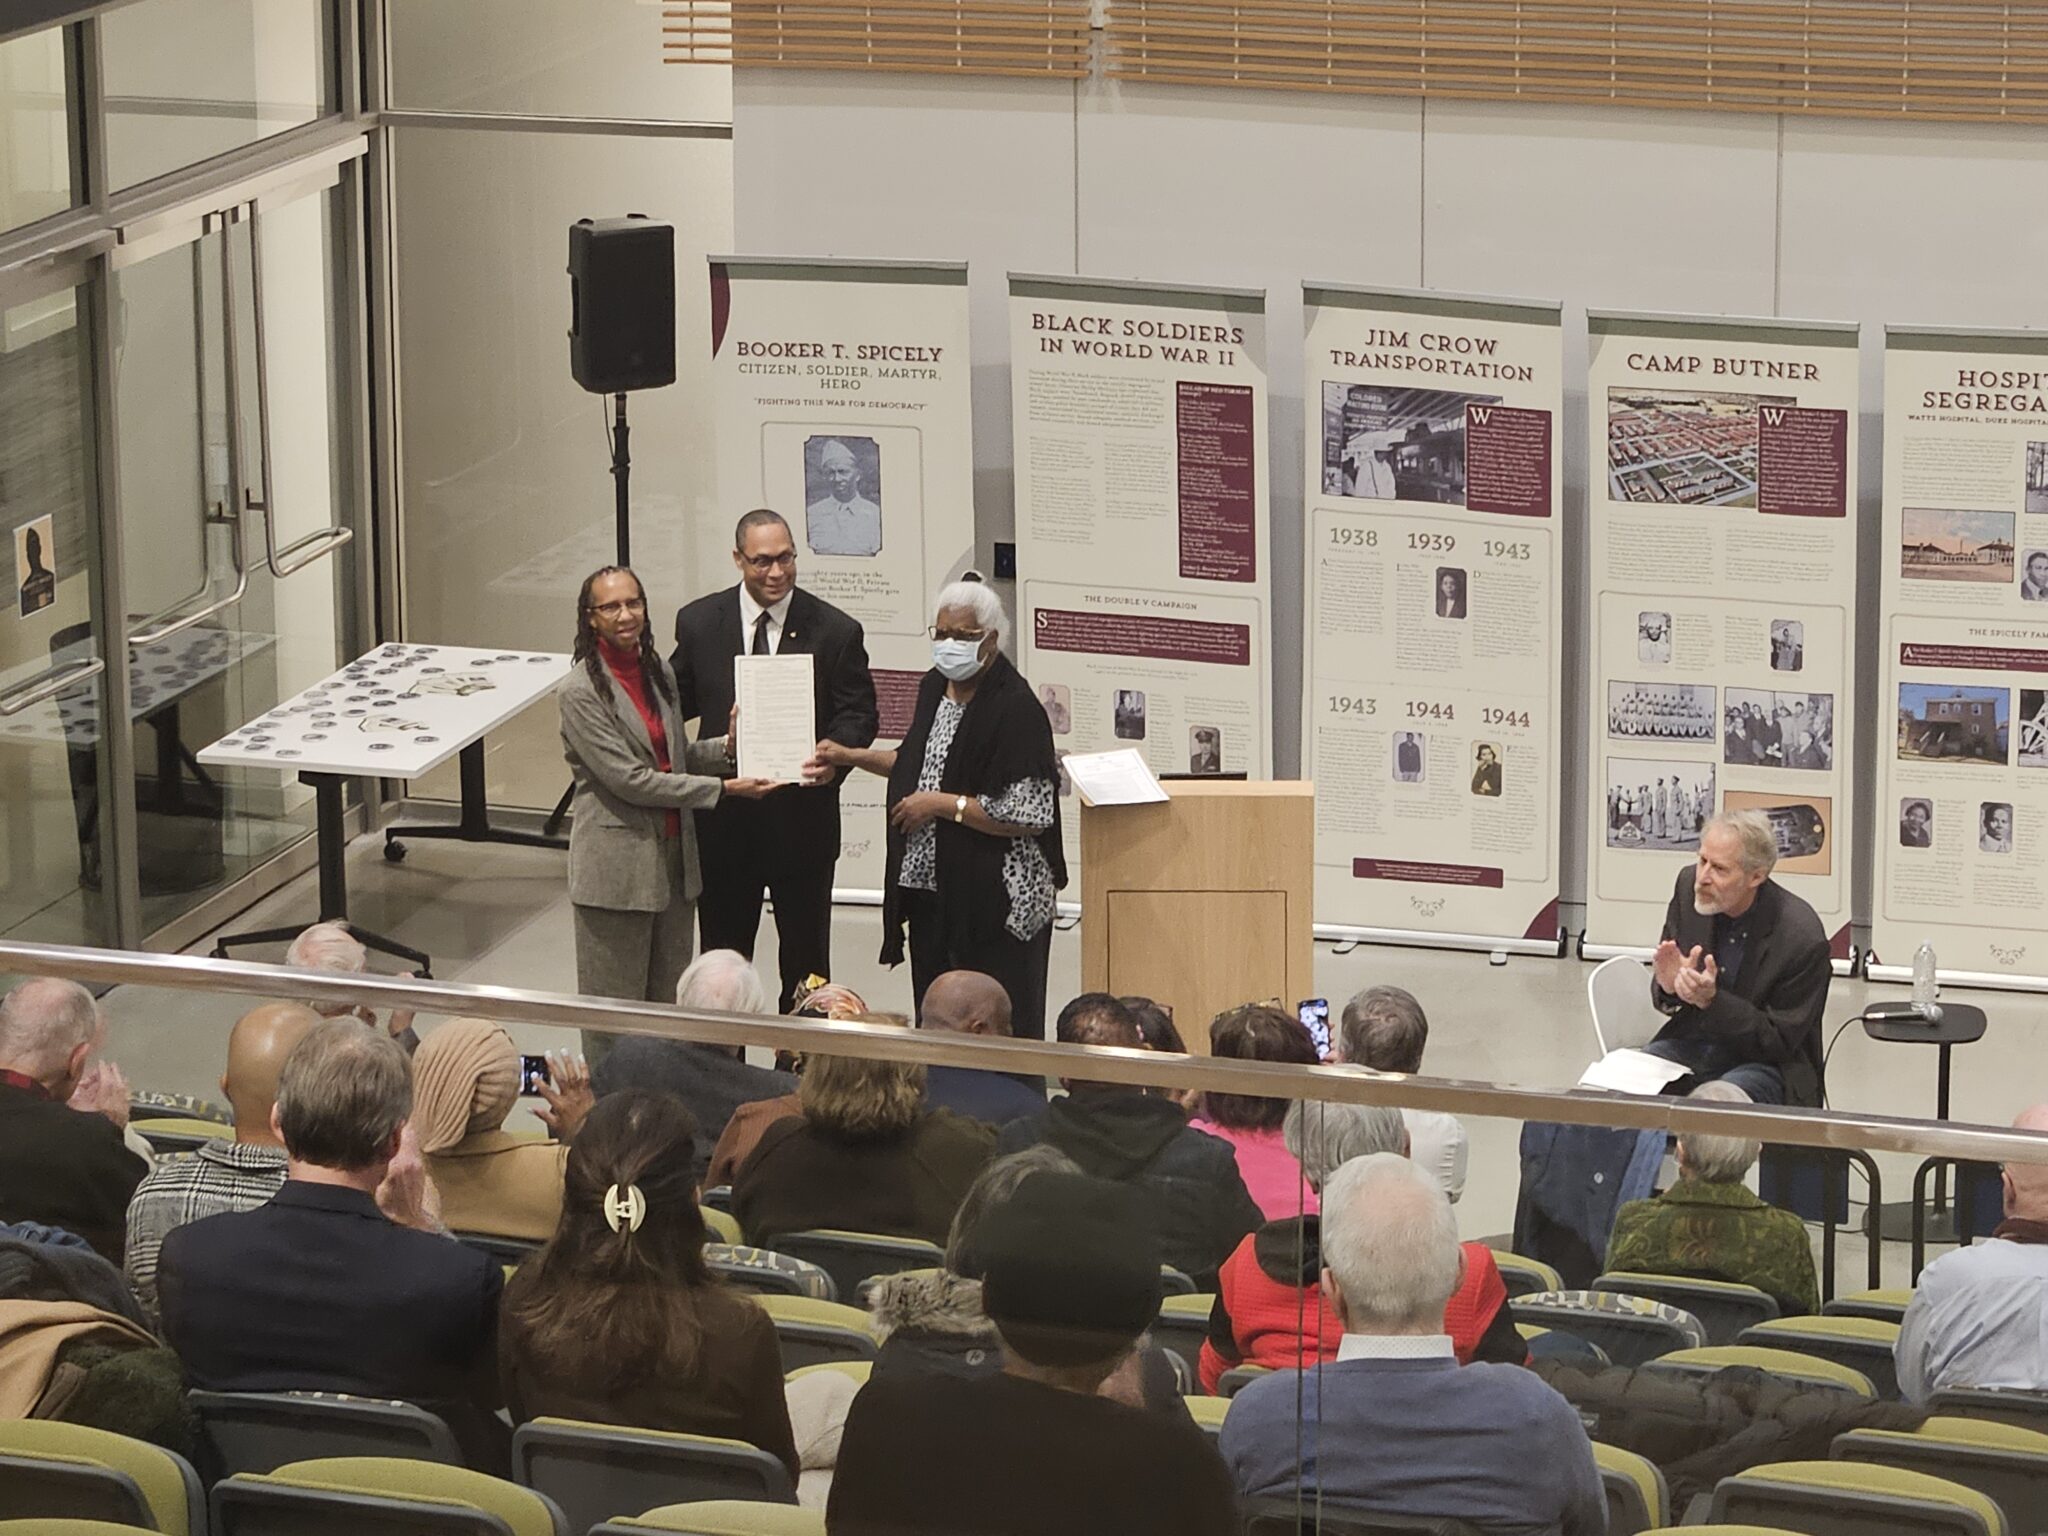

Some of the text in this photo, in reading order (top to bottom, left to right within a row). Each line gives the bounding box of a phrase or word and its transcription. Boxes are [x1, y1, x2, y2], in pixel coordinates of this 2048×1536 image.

[1031, 312, 1245, 345] BLACK SOLDIERS
[1040, 337, 1236, 366] IN WORLD WAR II
[1365, 329, 1498, 355] JIM CROW
[737, 342, 943, 362] BOOKER T. SPICELY
[738, 363, 941, 380] CITIZEN, SOLDIER, MARTYR,
[1330, 349, 1534, 381] TRANSPORTATION
[1627, 353, 1820, 381] CAMP BUTNER
[820, 379, 861, 390] HERO
[803, 398, 824, 407] THIS
[826, 399, 845, 407] WAR
[1923, 391, 2048, 412] SEGREGA
[1330, 528, 1378, 547] 1938
[1407, 533, 1456, 552] 1939
[1483, 540, 1531, 561] 1943
[1084, 595, 1101, 603] THE
[1104, 596, 1140, 605] DOUBLE
[1151, 600, 1198, 610] CAMPAIGN
[1969, 628, 1986, 636] THE
[1329, 696, 1377, 715] 1943
[1406, 701, 1455, 720] 1944
[1482, 708, 1531, 728] 1944
